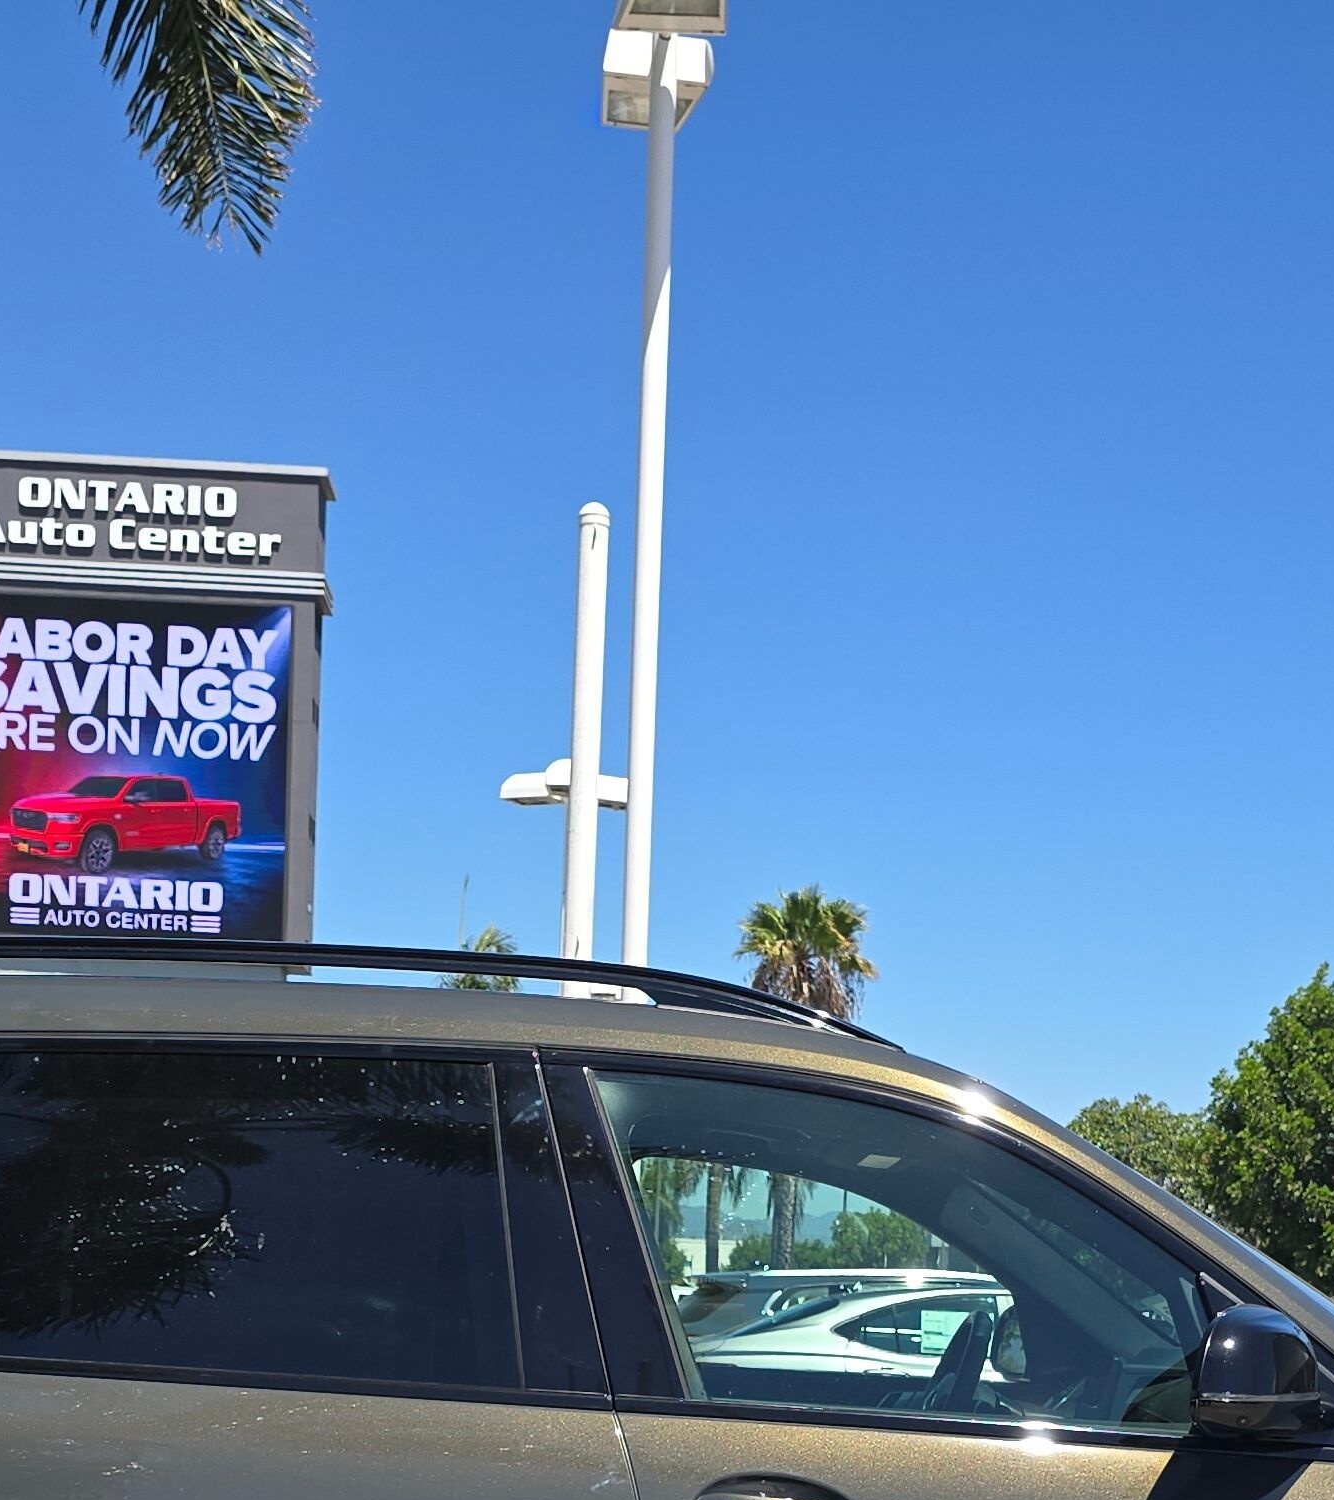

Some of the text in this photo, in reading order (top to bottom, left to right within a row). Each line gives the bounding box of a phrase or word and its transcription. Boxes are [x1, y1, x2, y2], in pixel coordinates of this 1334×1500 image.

[18, 476, 237, 518] ONTARIO
[109, 518, 282, 557] Center
[167, 624, 279, 670] DAY
[67, 715, 140, 756] ON
[152, 719, 277, 762] NOW
[8, 872, 224, 913] ONTARIO
[43, 908, 188, 932] AUTO CENTER
